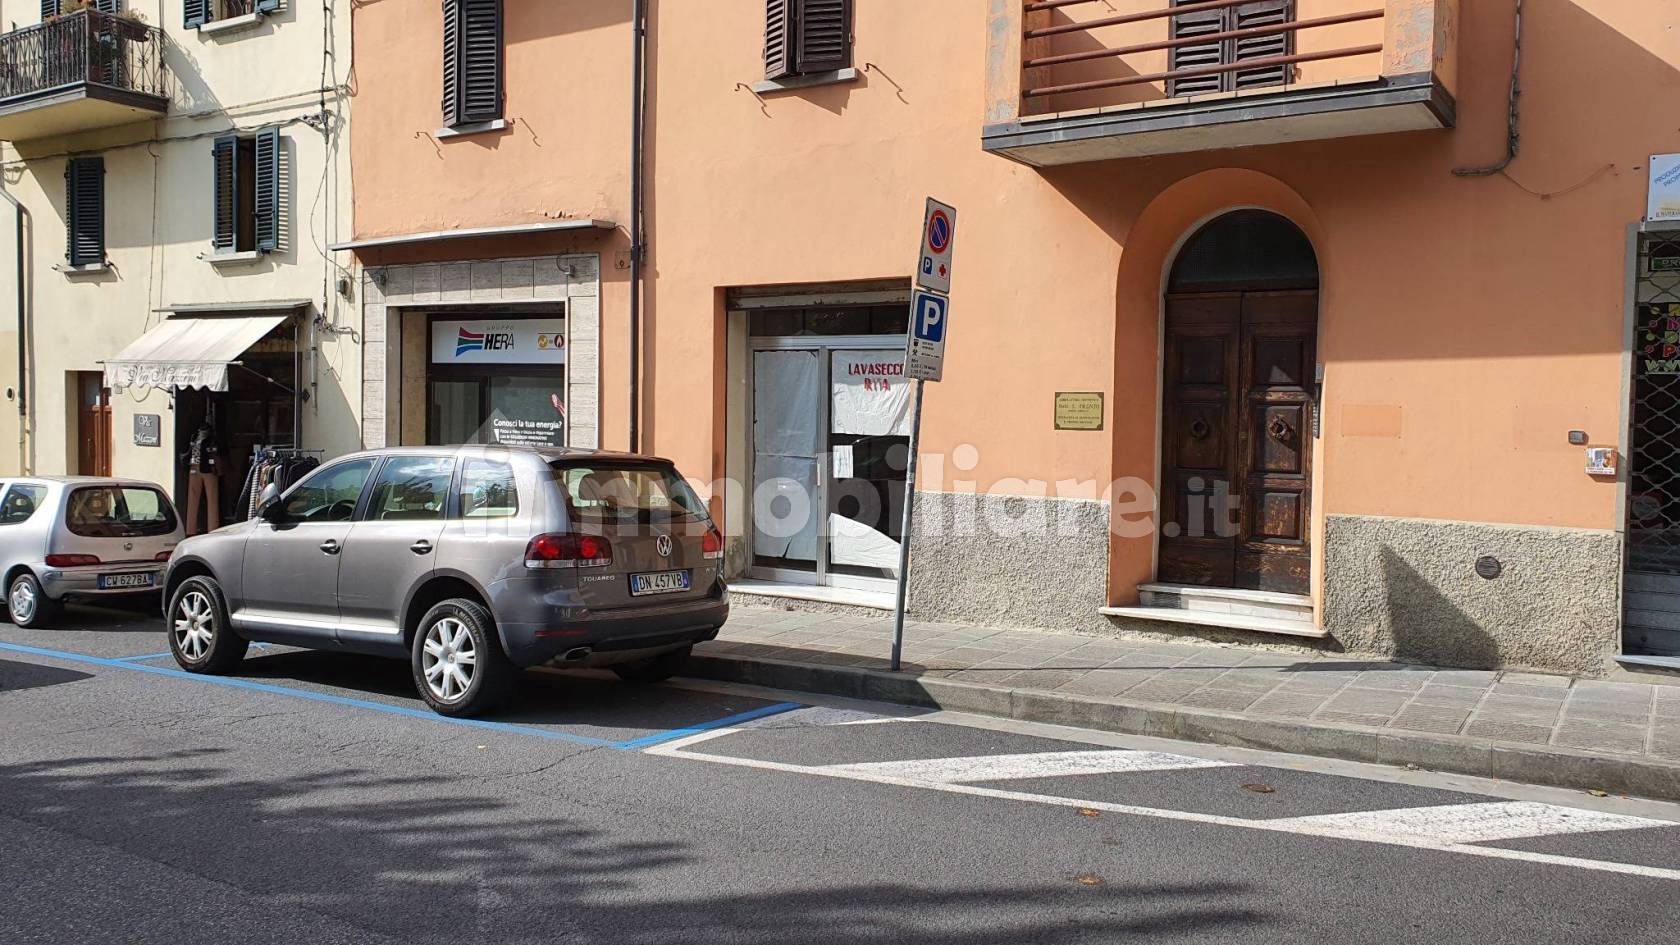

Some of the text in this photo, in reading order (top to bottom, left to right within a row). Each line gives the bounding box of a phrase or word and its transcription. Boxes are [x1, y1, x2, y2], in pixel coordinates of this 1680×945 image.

[922, 299, 941, 336] P
[484, 333, 515, 350] HERA
[493, 418, 562, 430] Conosci la tua energia?
[106, 575, 118, 587] CW
[639, 573, 683, 590] DN 457VB
